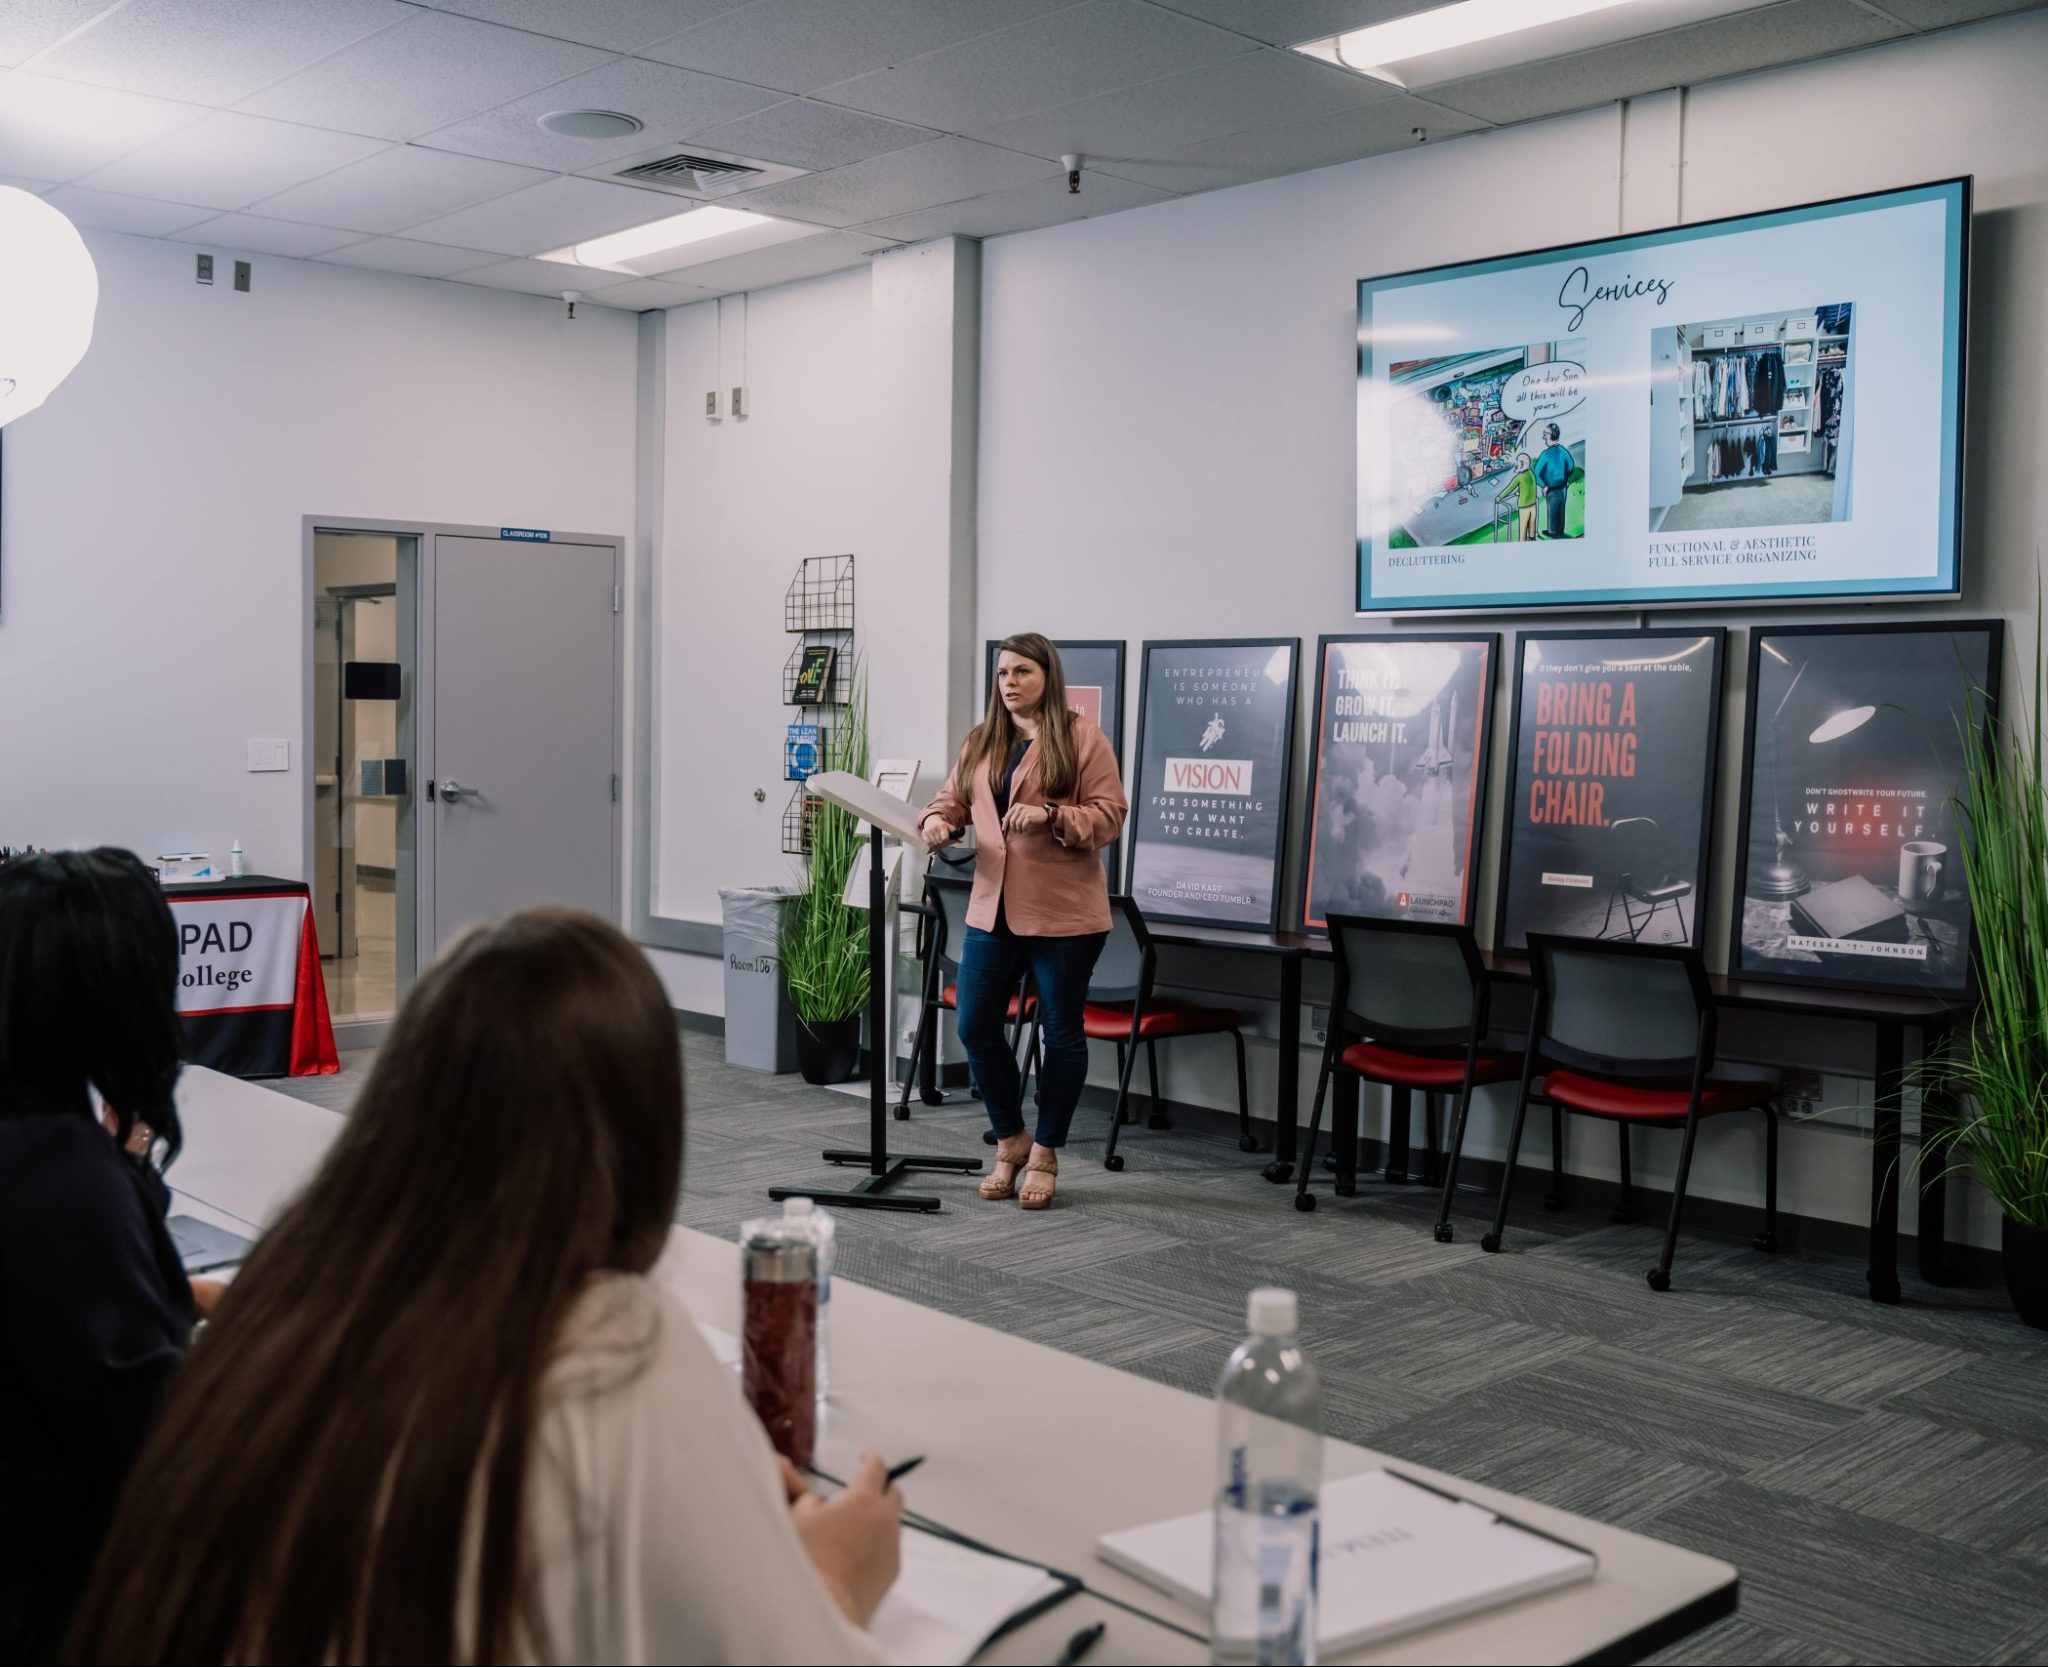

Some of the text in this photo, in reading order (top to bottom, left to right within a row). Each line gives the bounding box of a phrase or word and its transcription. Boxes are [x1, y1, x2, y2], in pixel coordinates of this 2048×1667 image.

[1558, 266, 1675, 332] Services
[1522, 368, 1579, 387] One day Son
[1516, 386, 1578, 402] all this will be
[1533, 403, 1559, 417] yours.
[502, 530, 534, 538] CLASSROOM
[1649, 535, 1816, 554] FUNCTIONAL & AESTHETIC
[1388, 554, 1465, 567] DECLUTTERING
[1649, 550, 1817, 568] FULL SERVICE ORGANIZING
[1545, 664, 1562, 673] they
[1564, 663, 1583, 672] don't
[1584, 664, 1600, 674] give
[1602, 665, 1618, 674] you
[1625, 664, 1642, 672] seat
[1643, 664, 1651, 672] at
[1653, 663, 1667, 672] the
[1668, 663, 1692, 673] table,
[1174, 682, 1257, 692] IS SOMEONE
[1176, 697, 1252, 706] WHO HAS A
[1335, 695, 1377, 716] GROW
[1536, 681, 1636, 726] BRING A
[1333, 721, 1408, 744] LAUNCH IT.
[1533, 730, 1637, 777] FOLDING
[1173, 763, 1241, 791] VISION
[1805, 787, 1928, 798] DON'T GHOSTWRITE YOUR FUTURE.
[1152, 796, 1263, 811] FOR SOMETHING
[1530, 779, 1610, 826] CHAIR.
[1806, 803, 1925, 818] WRITE IT
[1160, 811, 1246, 825] AND A WANT
[1164, 825, 1244, 839] TO CREATE.
[1794, 821, 1936, 838] YOURSELF.
[1176, 881, 1223, 893] DAVID KARP
[1148, 888, 1251, 905] FOUNDER AND CEO TUMBLR
[1410, 896, 1454, 908] LAUNCHPAD
[1791, 939, 1839, 949] NATESHA
[1870, 946, 1923, 955] JOHNSON
[178, 964, 253, 991] ollege
